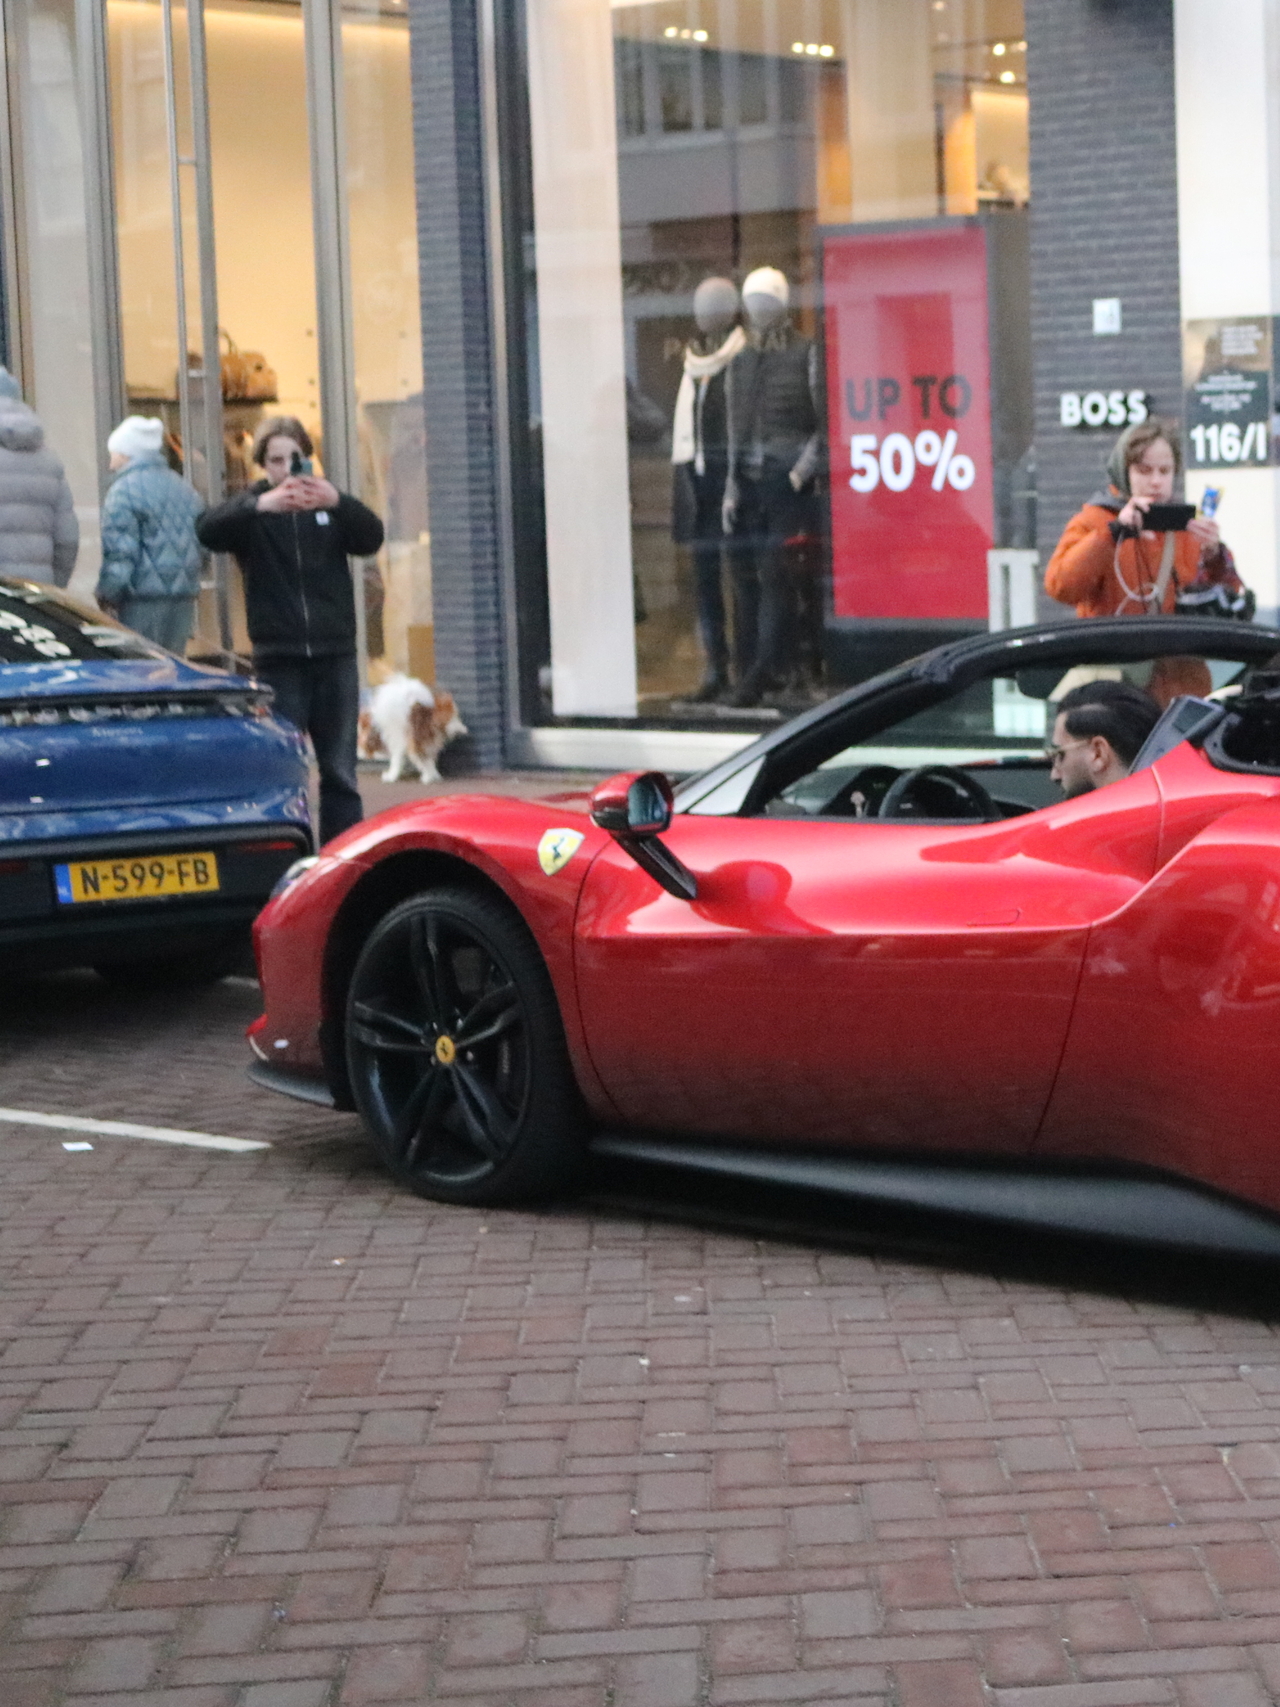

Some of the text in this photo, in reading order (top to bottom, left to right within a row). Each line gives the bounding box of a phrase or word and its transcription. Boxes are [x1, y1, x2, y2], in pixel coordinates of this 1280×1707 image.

[845, 374, 972, 422] UP TO
[1060, 390, 1149, 427] BOSS
[849, 429, 976, 492] 50%
[80, 858, 210, 897] N-599-FB
